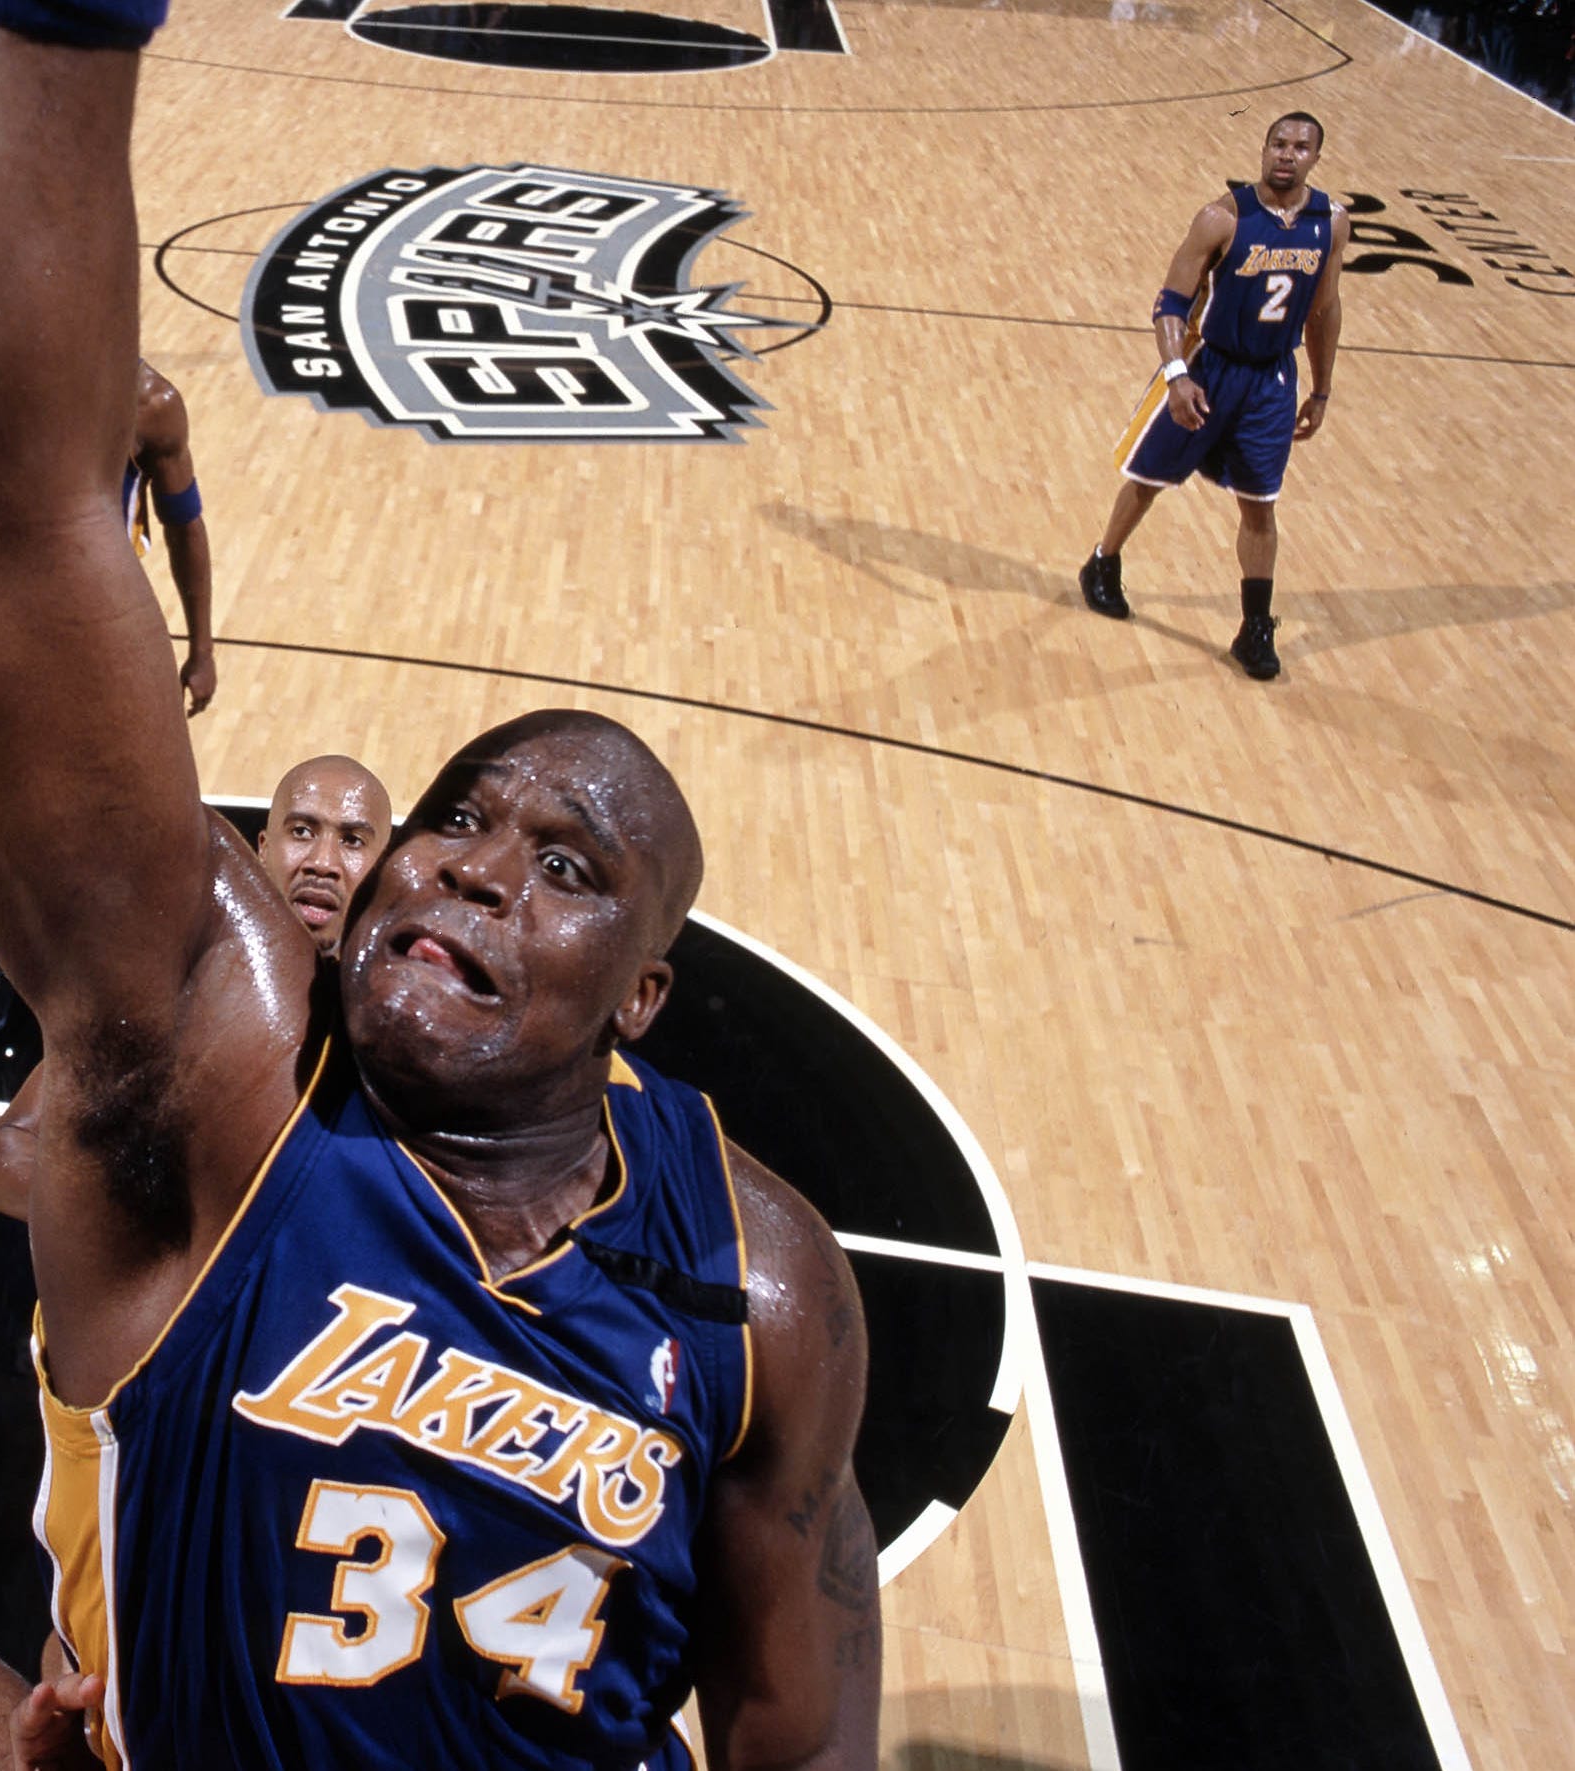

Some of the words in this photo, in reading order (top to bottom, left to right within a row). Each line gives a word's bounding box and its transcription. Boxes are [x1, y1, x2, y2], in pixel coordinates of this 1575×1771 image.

[286, 177, 427, 291] ANTONIO
[1235, 244, 1322, 276] LAKERS
[281, 304, 342, 378] SAN
[387, 178, 661, 412] SPURS
[1258, 274, 1293, 322] 2
[232, 1283, 685, 1547] LAKERS
[275, 1479, 634, 1715] 34
